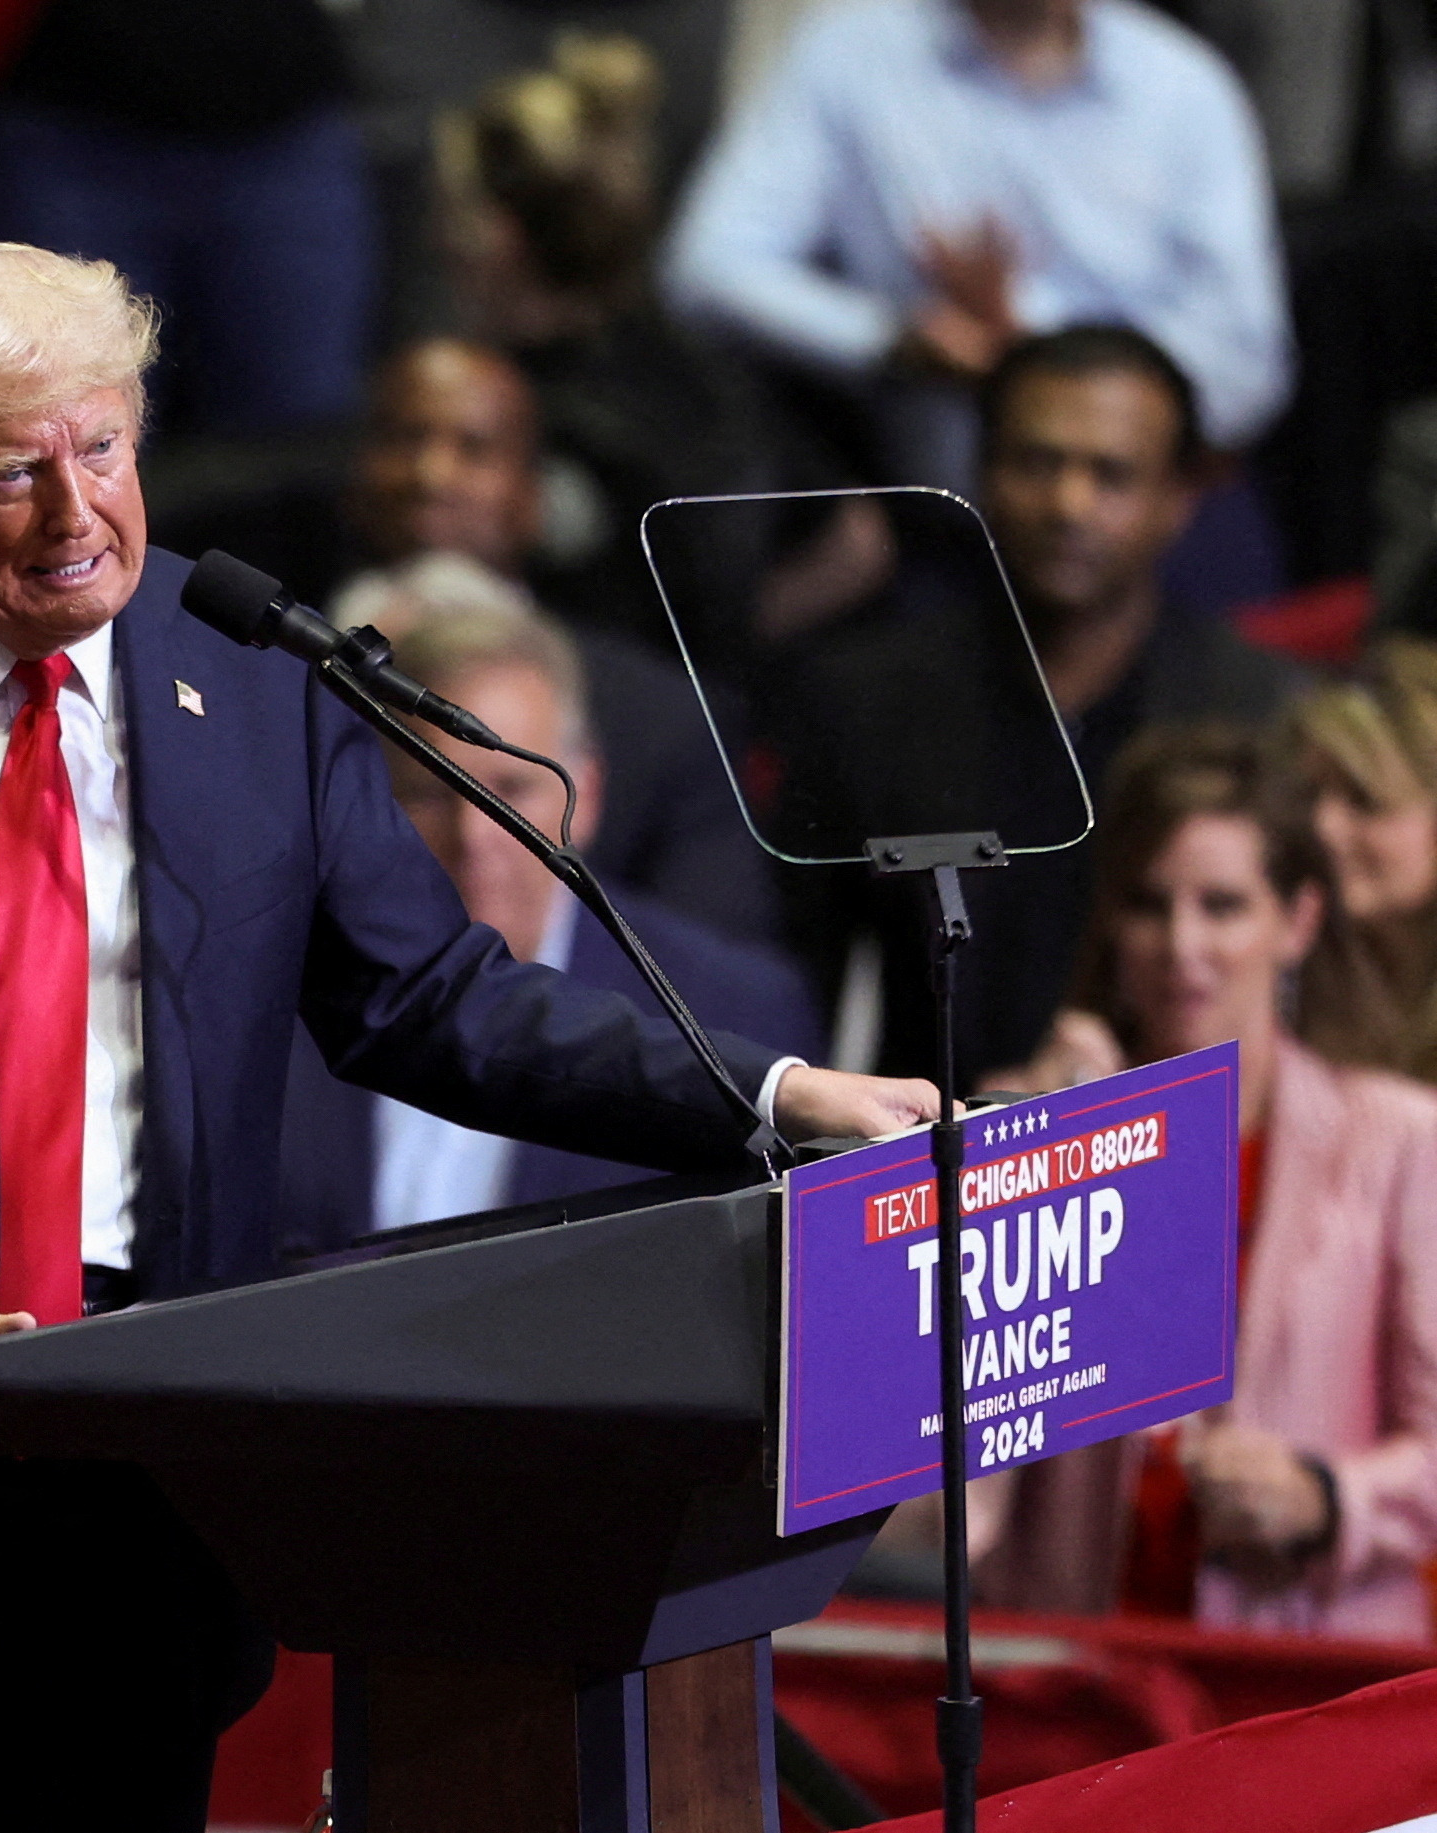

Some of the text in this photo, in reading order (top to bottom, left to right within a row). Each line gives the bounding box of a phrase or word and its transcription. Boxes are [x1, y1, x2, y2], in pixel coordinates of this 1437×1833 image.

[874, 1117, 1159, 1238] TEXT CHIGAN TO 88022
[907, 1187, 1125, 1336] TRUMP
[961, 1306, 1072, 1391] VANCE
[920, 1414, 944, 1438] MA
[1019, 1377, 1060, 1408] GREAT
[1062, 1363, 1106, 1395] AGAIN!
[980, 1411, 1045, 1468] 2024
